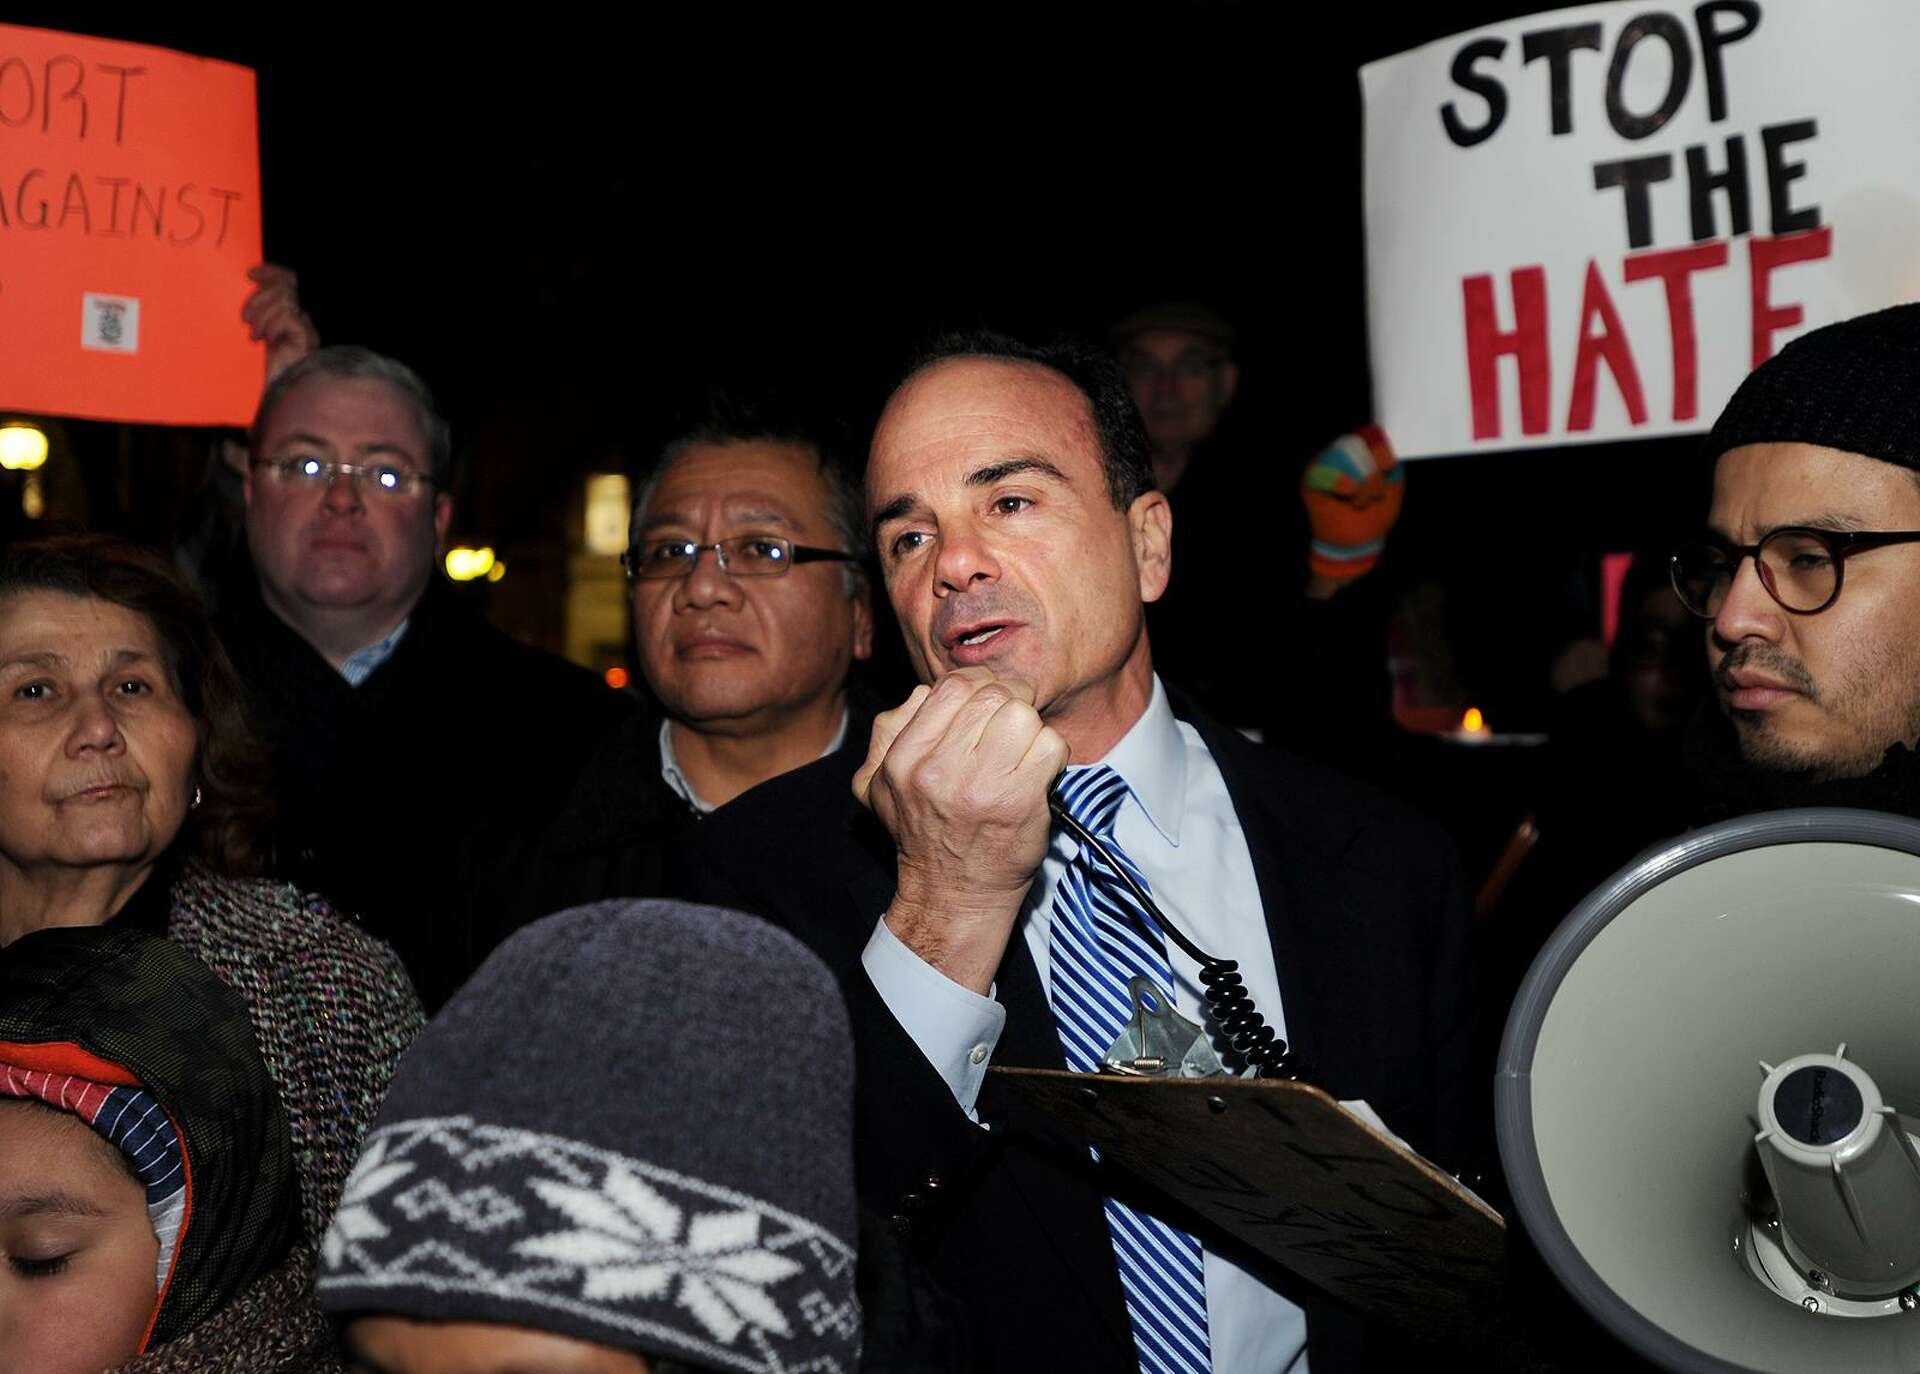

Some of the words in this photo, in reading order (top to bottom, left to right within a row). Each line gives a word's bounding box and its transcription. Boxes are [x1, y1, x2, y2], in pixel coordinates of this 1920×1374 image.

[0, 55, 146, 146] ORT
[1441, 0, 1761, 147] STOP
[1593, 119, 1819, 249] THE
